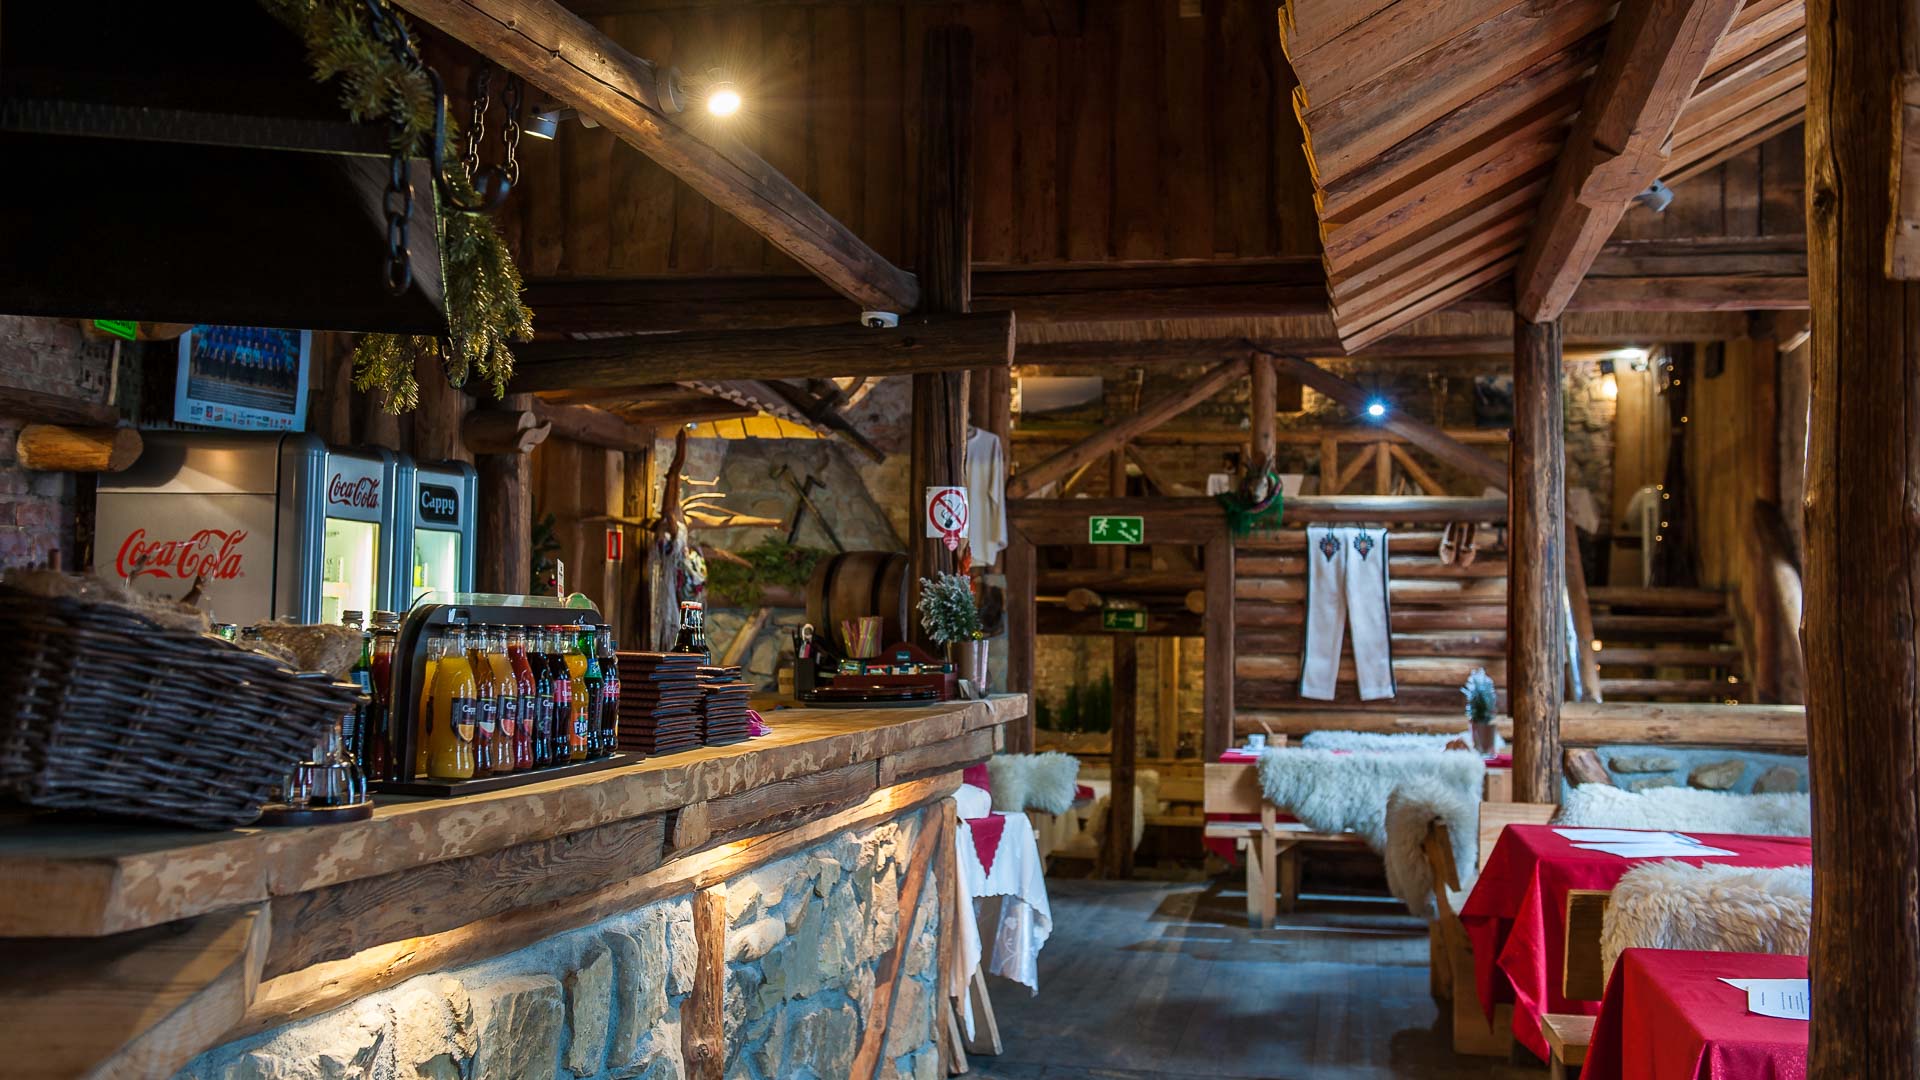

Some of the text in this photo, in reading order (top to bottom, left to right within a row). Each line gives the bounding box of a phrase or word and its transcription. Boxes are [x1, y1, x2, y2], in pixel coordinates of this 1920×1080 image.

[329, 473, 380, 509] Coca-Cola
[422, 491, 455, 516] Cappy
[115, 528, 248, 579] Coca-Cola
